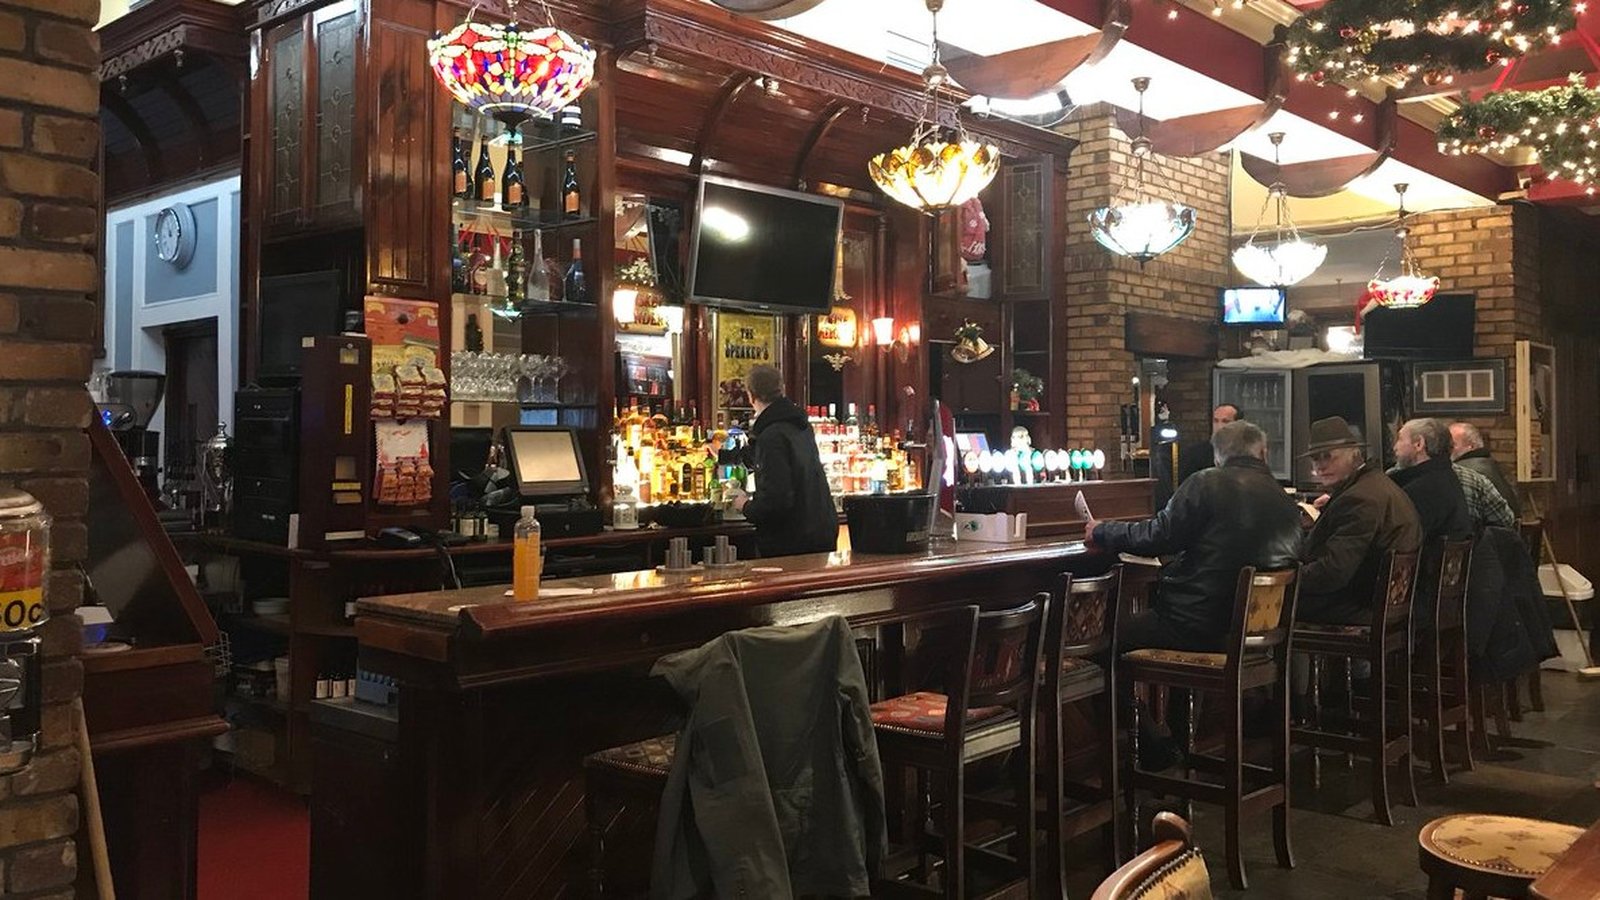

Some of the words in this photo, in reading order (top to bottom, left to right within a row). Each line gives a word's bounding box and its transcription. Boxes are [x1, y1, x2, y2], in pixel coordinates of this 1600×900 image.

[741, 327, 754, 340] THE
[725, 340, 769, 361] SPEAKER'S
[0, 599, 43, 628] 0c
